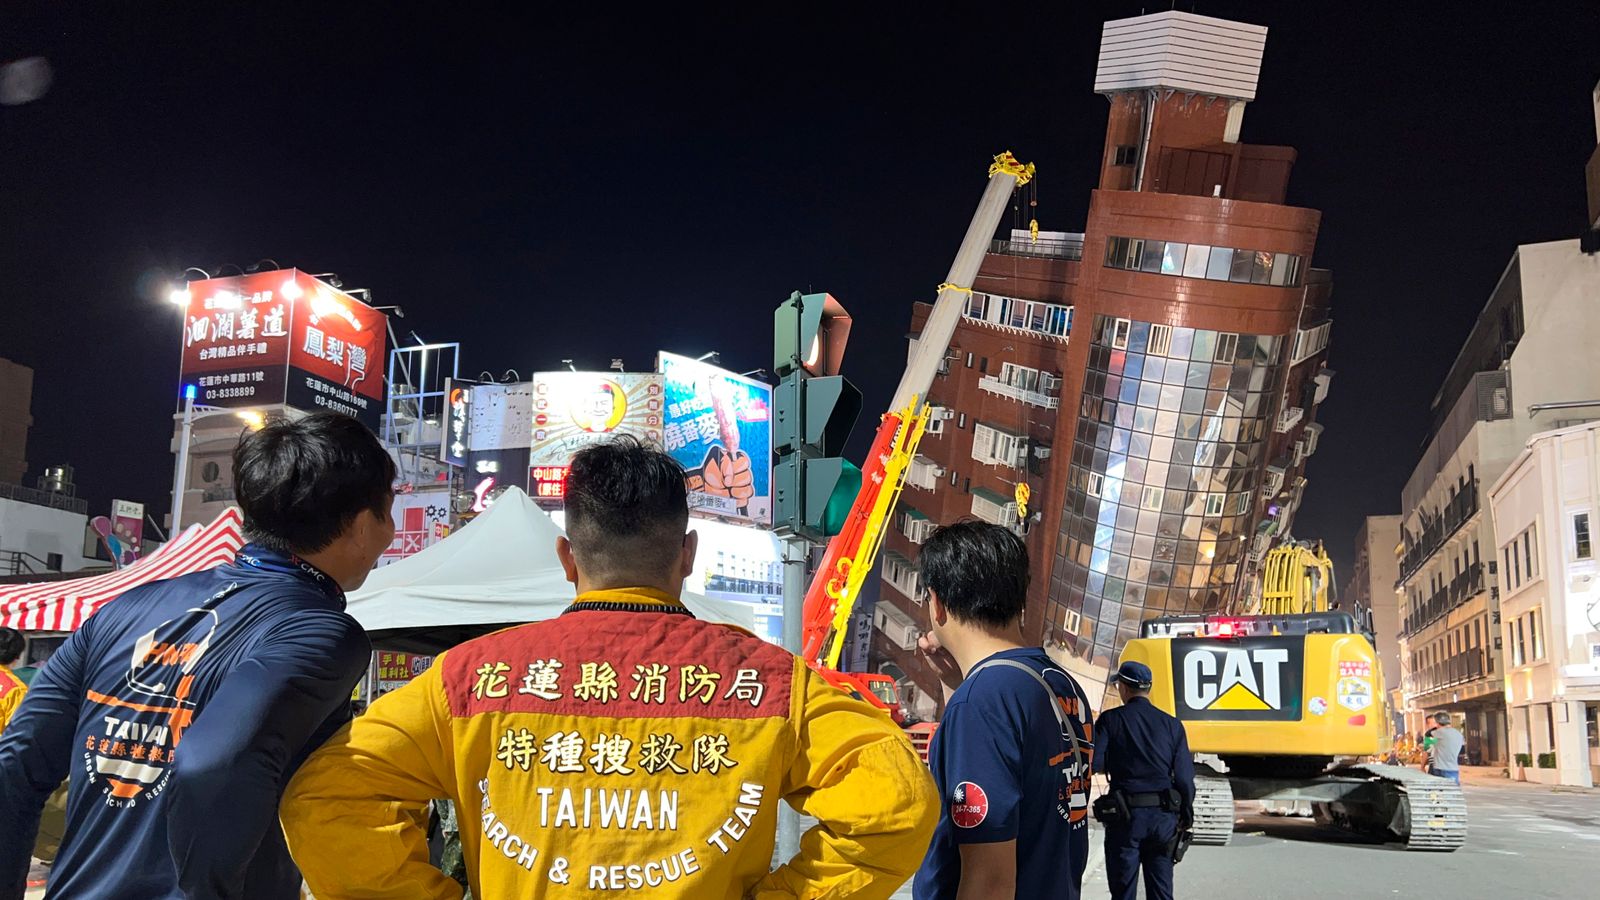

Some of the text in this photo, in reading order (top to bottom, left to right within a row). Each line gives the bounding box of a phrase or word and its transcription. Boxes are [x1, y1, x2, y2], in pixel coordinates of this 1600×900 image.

[198, 371, 264, 386] 花蓮市中華路11號
[206, 386, 255, 400] 03-8338899
[315, 395, 358, 417] 03-8360777
[538, 483, 564, 496] (原住
[300, 563, 325, 581] CMC
[471, 658, 765, 707] 花蓮縣消防局
[1183, 648, 1289, 710] CAT
[496, 727, 738, 775] 特種搜救隊
[536, 787, 679, 831] TAIWAN
[477, 777, 765, 890] SEARCH & RESCUE TEAM
